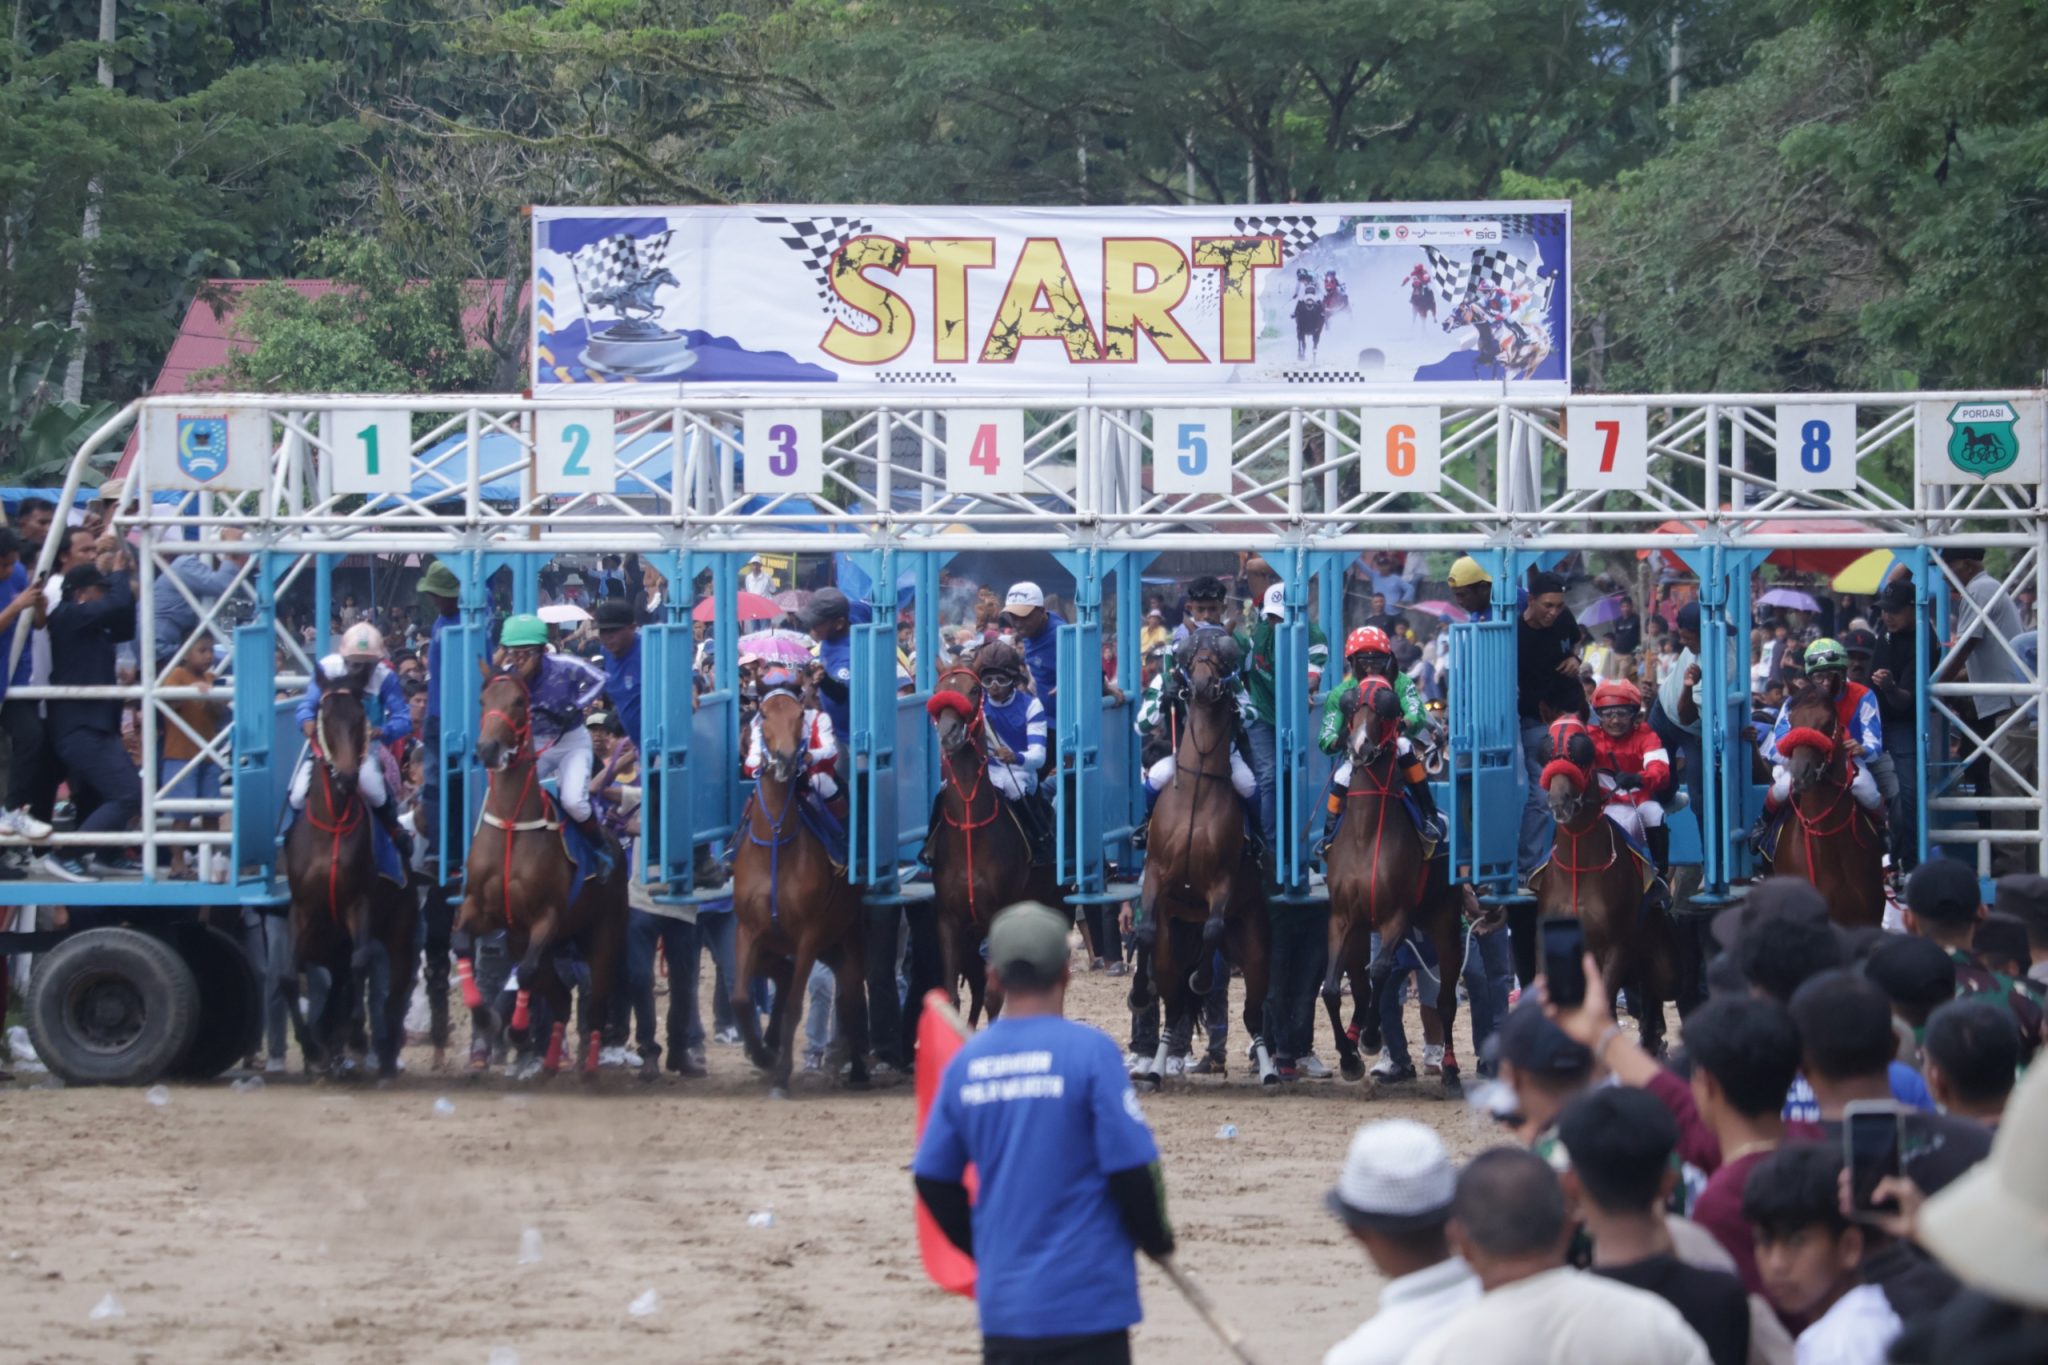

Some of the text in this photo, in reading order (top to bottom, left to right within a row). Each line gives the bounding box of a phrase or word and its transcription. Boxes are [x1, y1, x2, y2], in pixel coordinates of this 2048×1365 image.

[819, 234, 1284, 364] START
[1962, 408, 2004, 419] PORDASI
[357, 424, 380, 476] 1
[561, 423, 590, 476] 2
[769, 424, 797, 476] 3
[969, 424, 999, 474] 4
[1177, 423, 1208, 476] 5
[1386, 424, 1416, 477] 6
[1594, 420, 1621, 473] 7
[1800, 419, 1832, 474] 8
